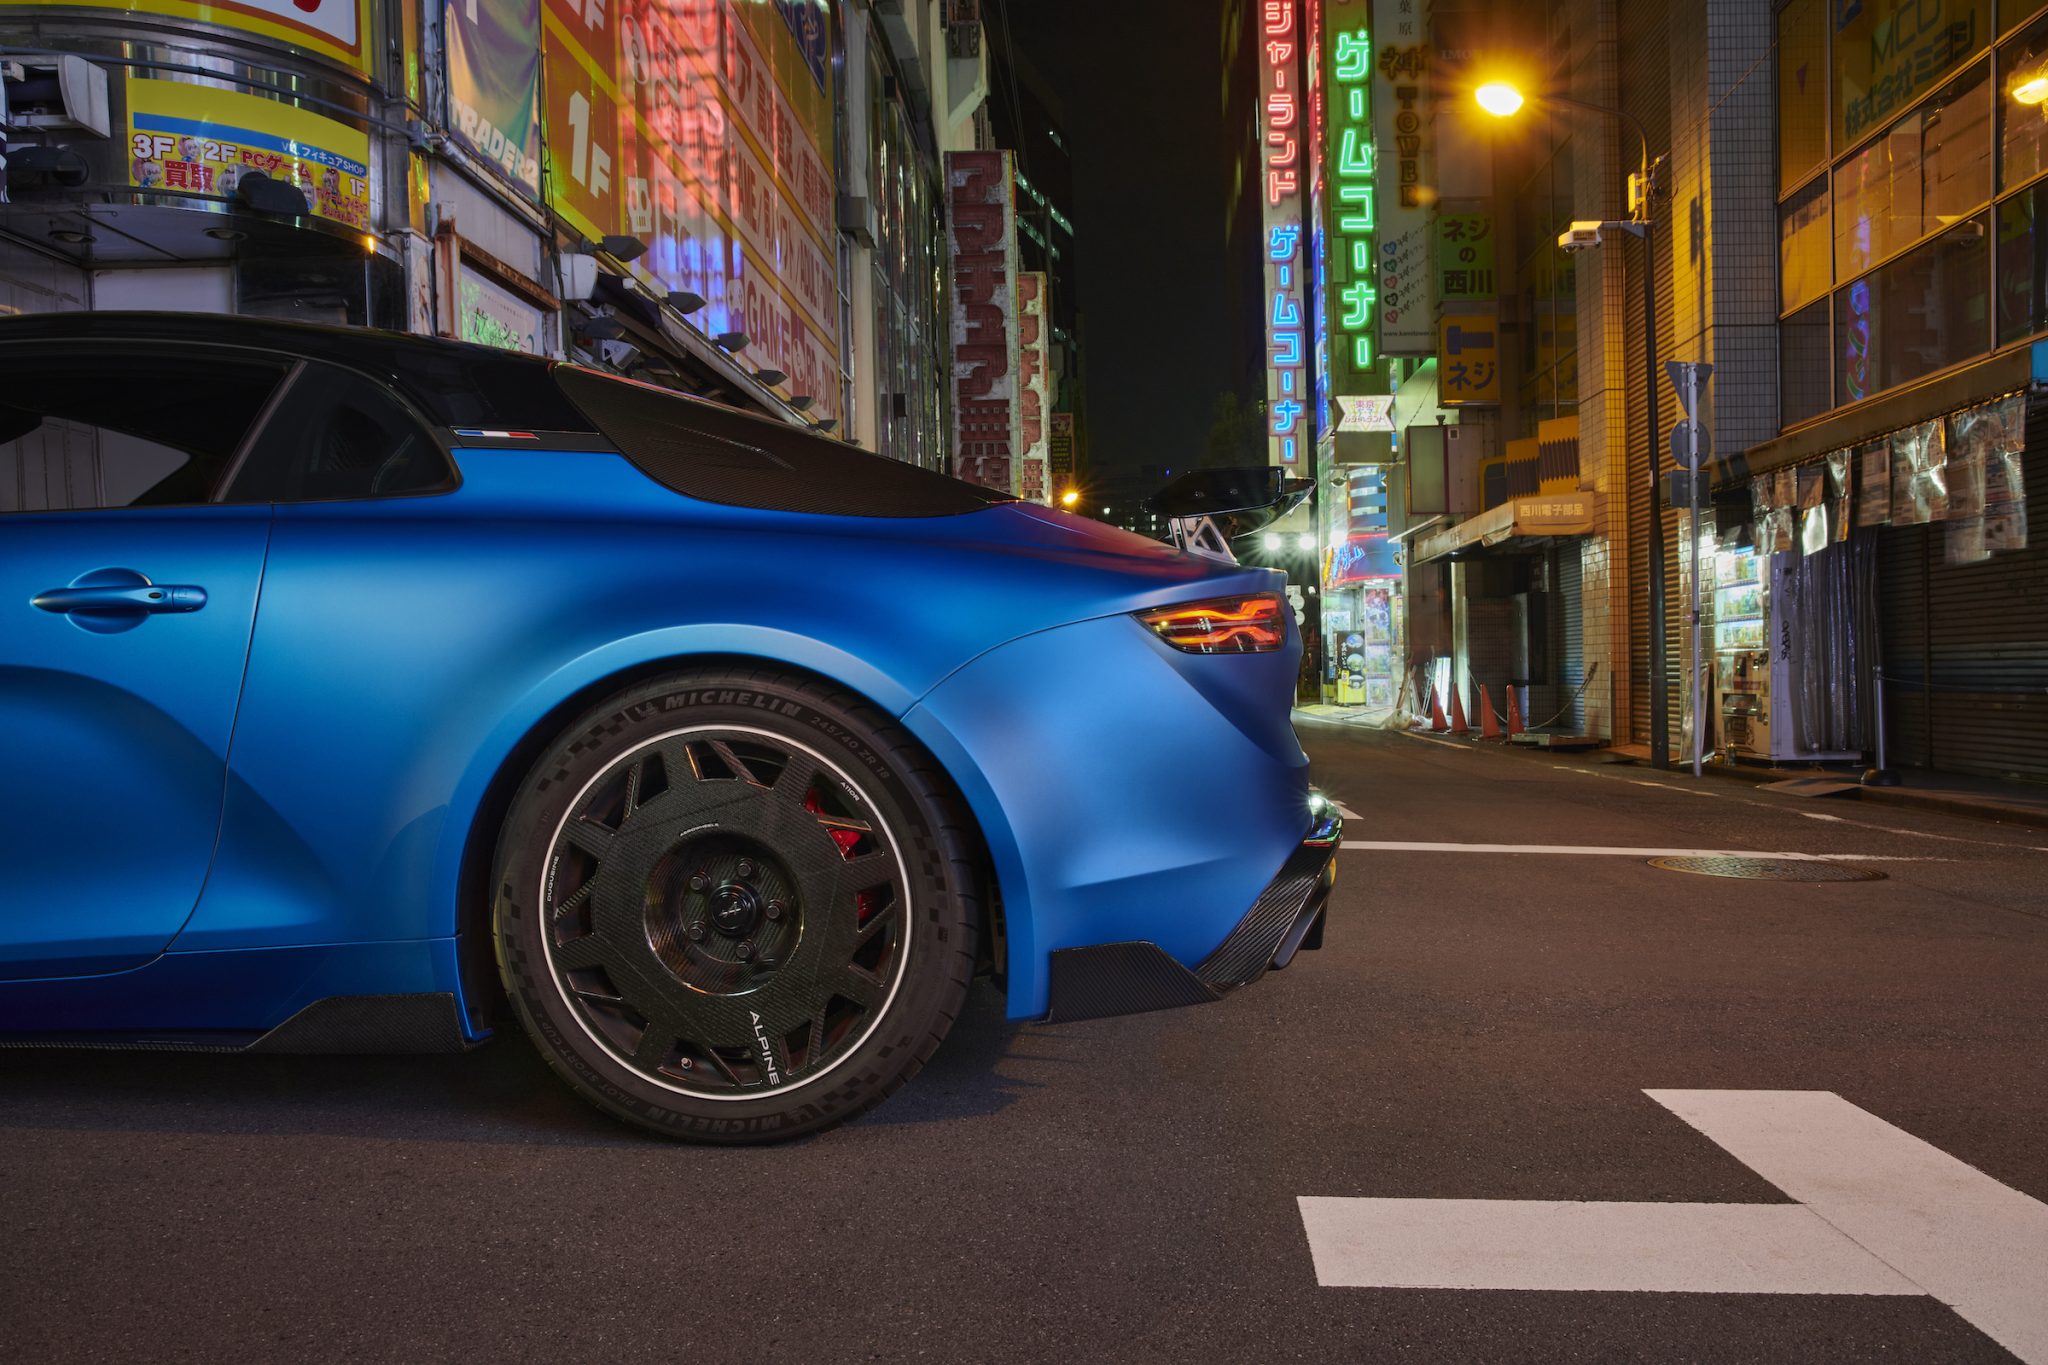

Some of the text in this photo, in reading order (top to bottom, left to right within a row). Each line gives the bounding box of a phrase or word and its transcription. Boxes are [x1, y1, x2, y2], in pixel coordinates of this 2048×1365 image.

[132, 134, 237, 162] 3F 2F
[568, 90, 611, 199] 1F
[164, 160, 214, 192] 買取
[349, 178, 366, 197] 1F
[1335, 28, 1376, 366] ゲームコーナー
[1443, 217, 1491, 243] ネジ
[1459, 246, 1477, 263] の
[1443, 269, 1493, 295] 西川
[747, 278, 791, 378] GAME
[1270, 224, 1300, 460] ゲームコーナー
[1447, 361, 1495, 392] ネジ
[1519, 502, 1585, 518] 西川電子部品
[664, 688, 802, 719] MICHELIN
[810, 715, 890, 780] 245/40 ZR 18
[749, 1010, 780, 1086] ALPINE
[560, 1048, 600, 1083] SPORT
[599, 1083, 637, 1107] PILOT
[646, 1104, 783, 1135] MICHELIN
